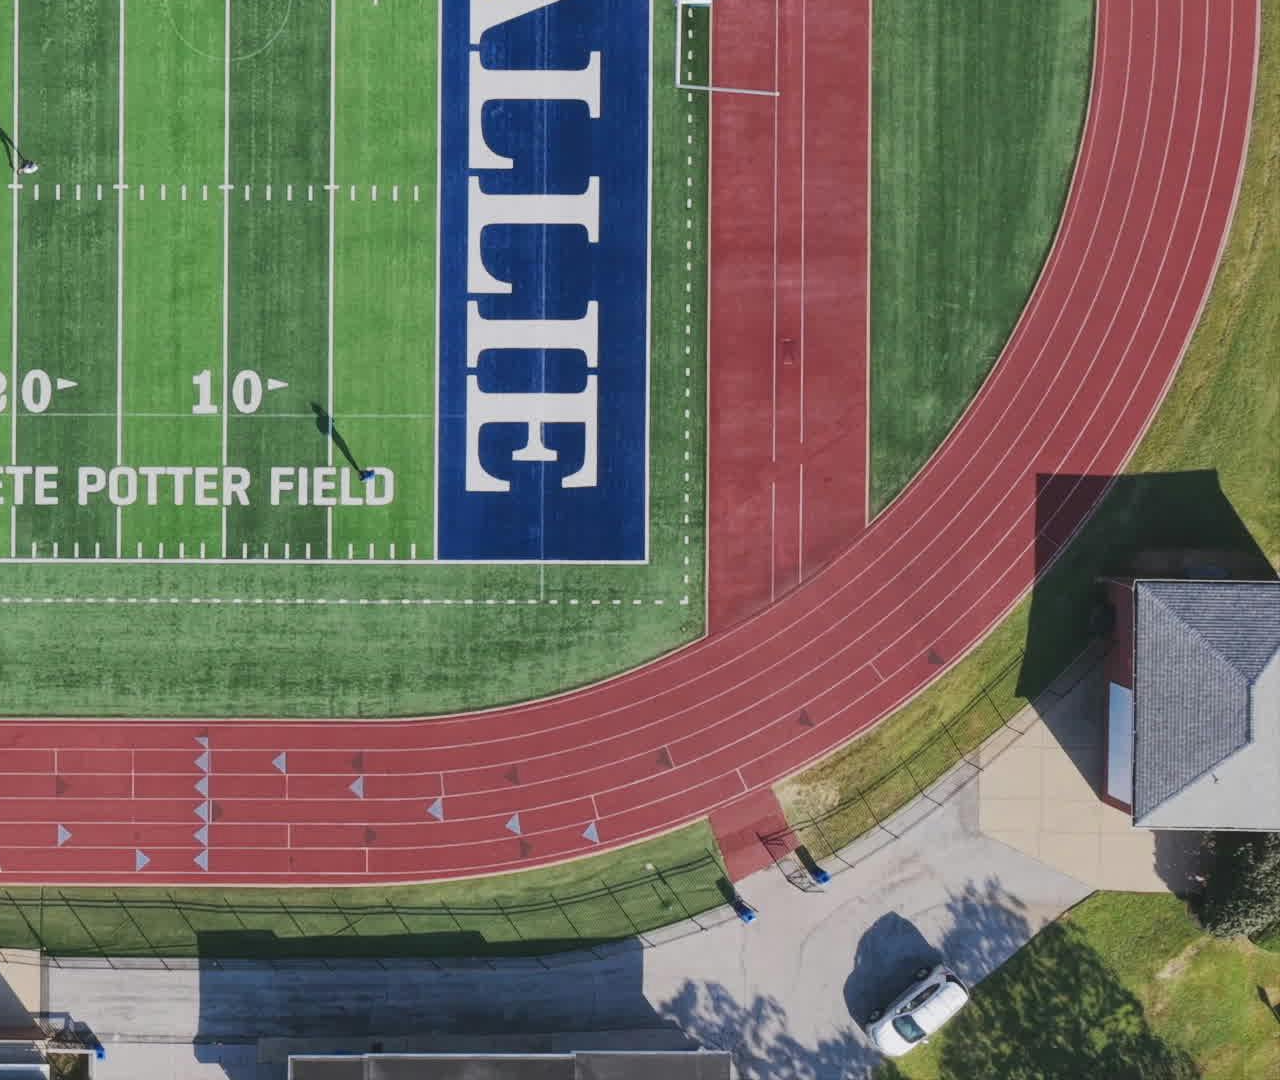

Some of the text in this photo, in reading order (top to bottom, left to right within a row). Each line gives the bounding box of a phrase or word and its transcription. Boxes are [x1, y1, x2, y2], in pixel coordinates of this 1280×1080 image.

[192, 370, 263, 414] 10
[78, 466, 250, 506] POTTER
[270, 467, 395, 507] FIELD
